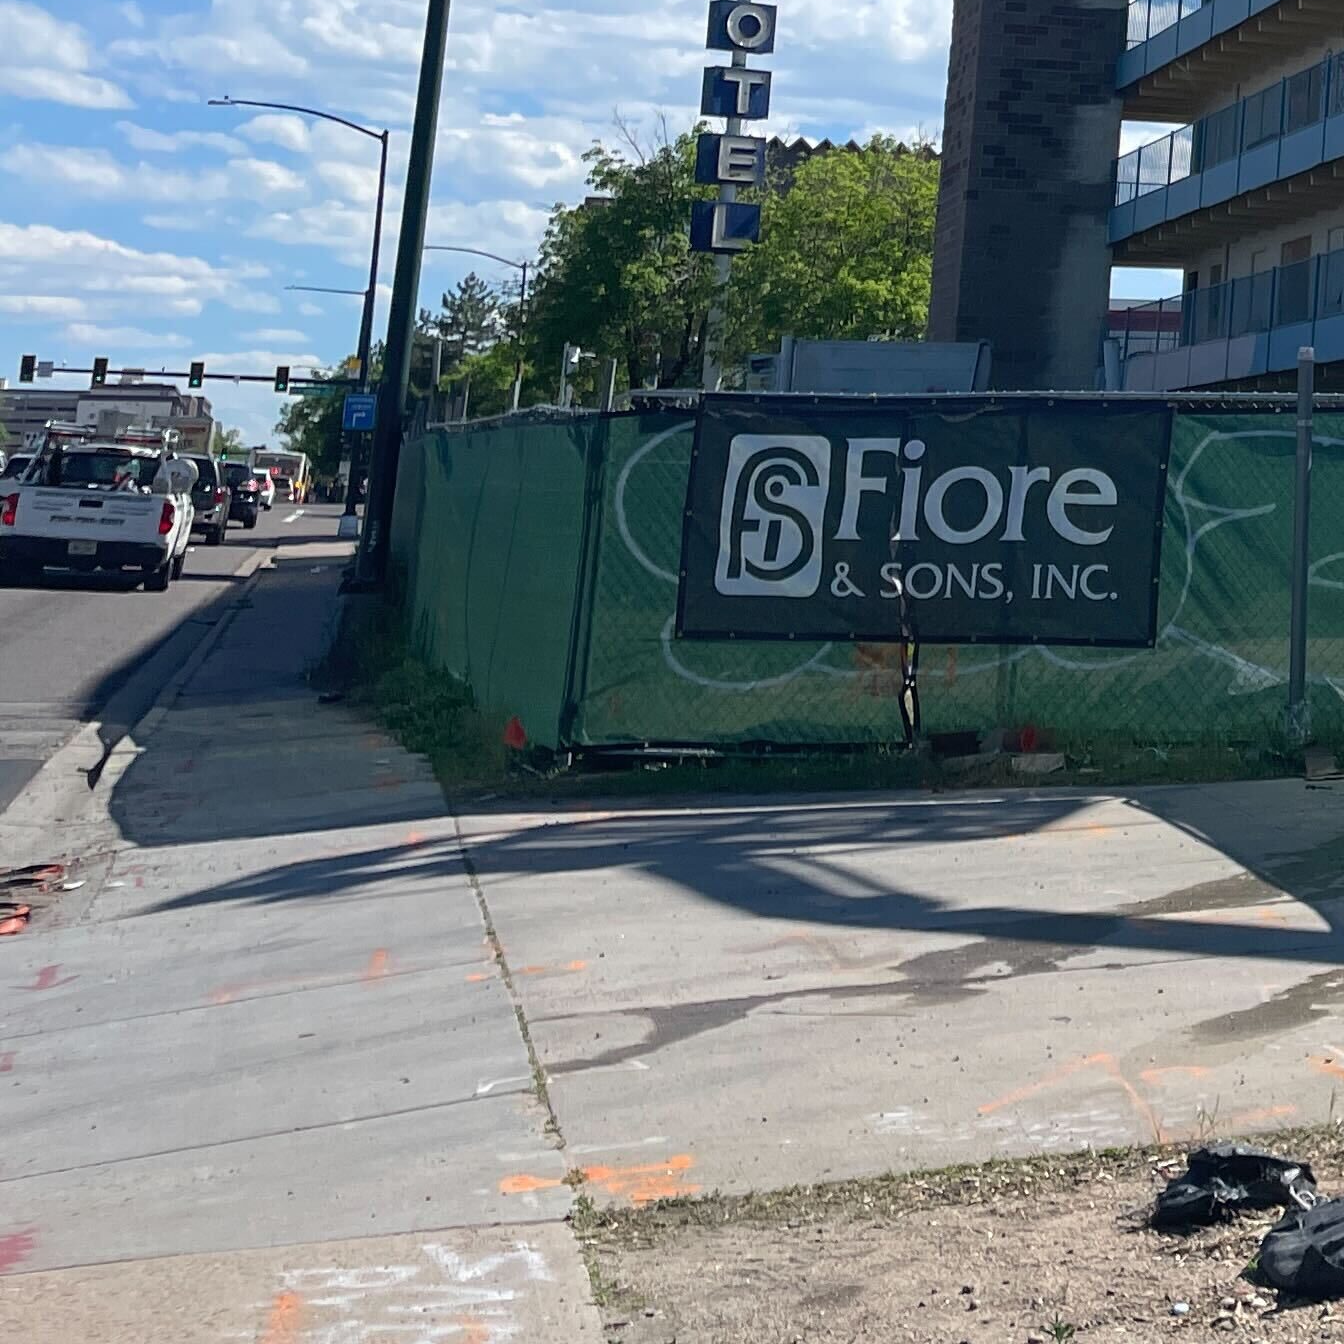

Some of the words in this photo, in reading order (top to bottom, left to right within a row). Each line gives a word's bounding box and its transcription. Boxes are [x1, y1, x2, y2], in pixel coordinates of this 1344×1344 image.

[834, 437, 1118, 545] Fiore
[829, 561, 866, 598] &
[879, 562, 1014, 602] SONS,
[1032, 563, 1118, 601] INC.
